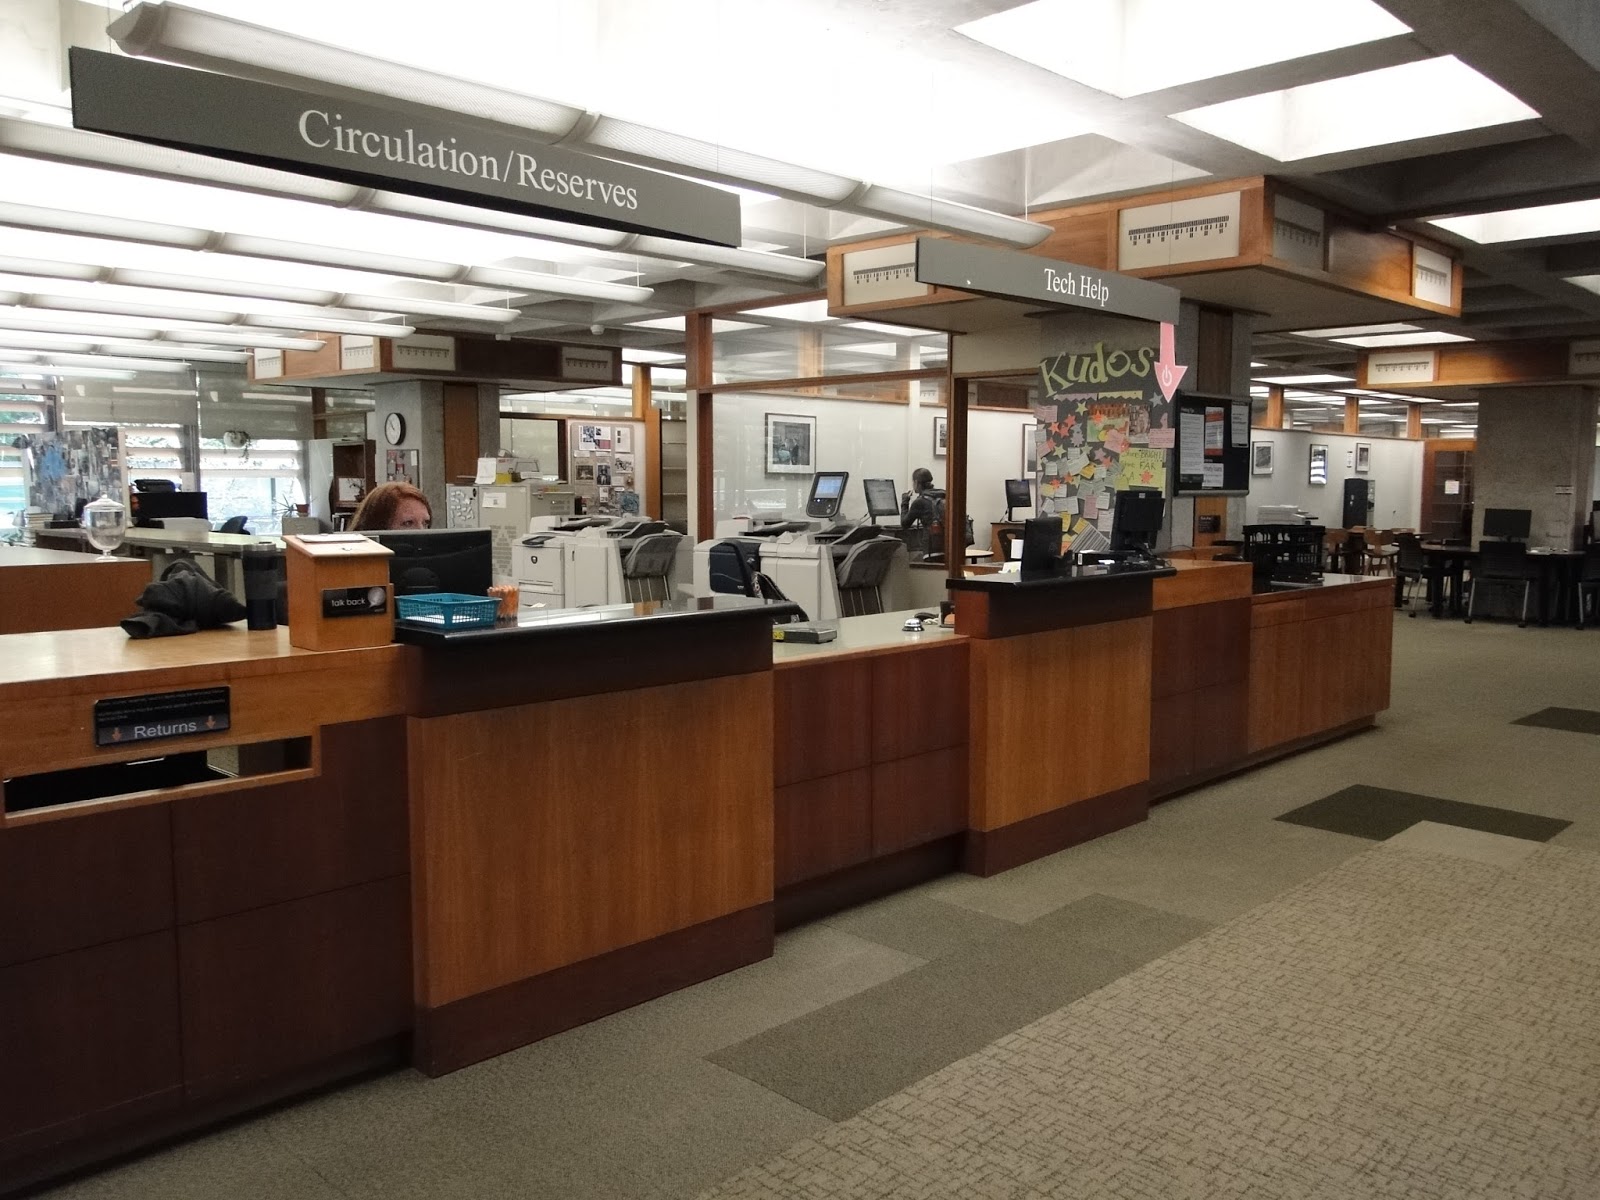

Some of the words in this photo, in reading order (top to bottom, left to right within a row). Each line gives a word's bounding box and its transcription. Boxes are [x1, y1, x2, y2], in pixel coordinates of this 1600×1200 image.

[298, 108, 638, 211] Circulation/Reserves
[1043, 267, 1076, 296] Tech
[1079, 275, 1110, 308] Help
[1039, 341, 1155, 398] Kudos
[346, 597, 366, 606] back
[133, 721, 198, 739] Returns
